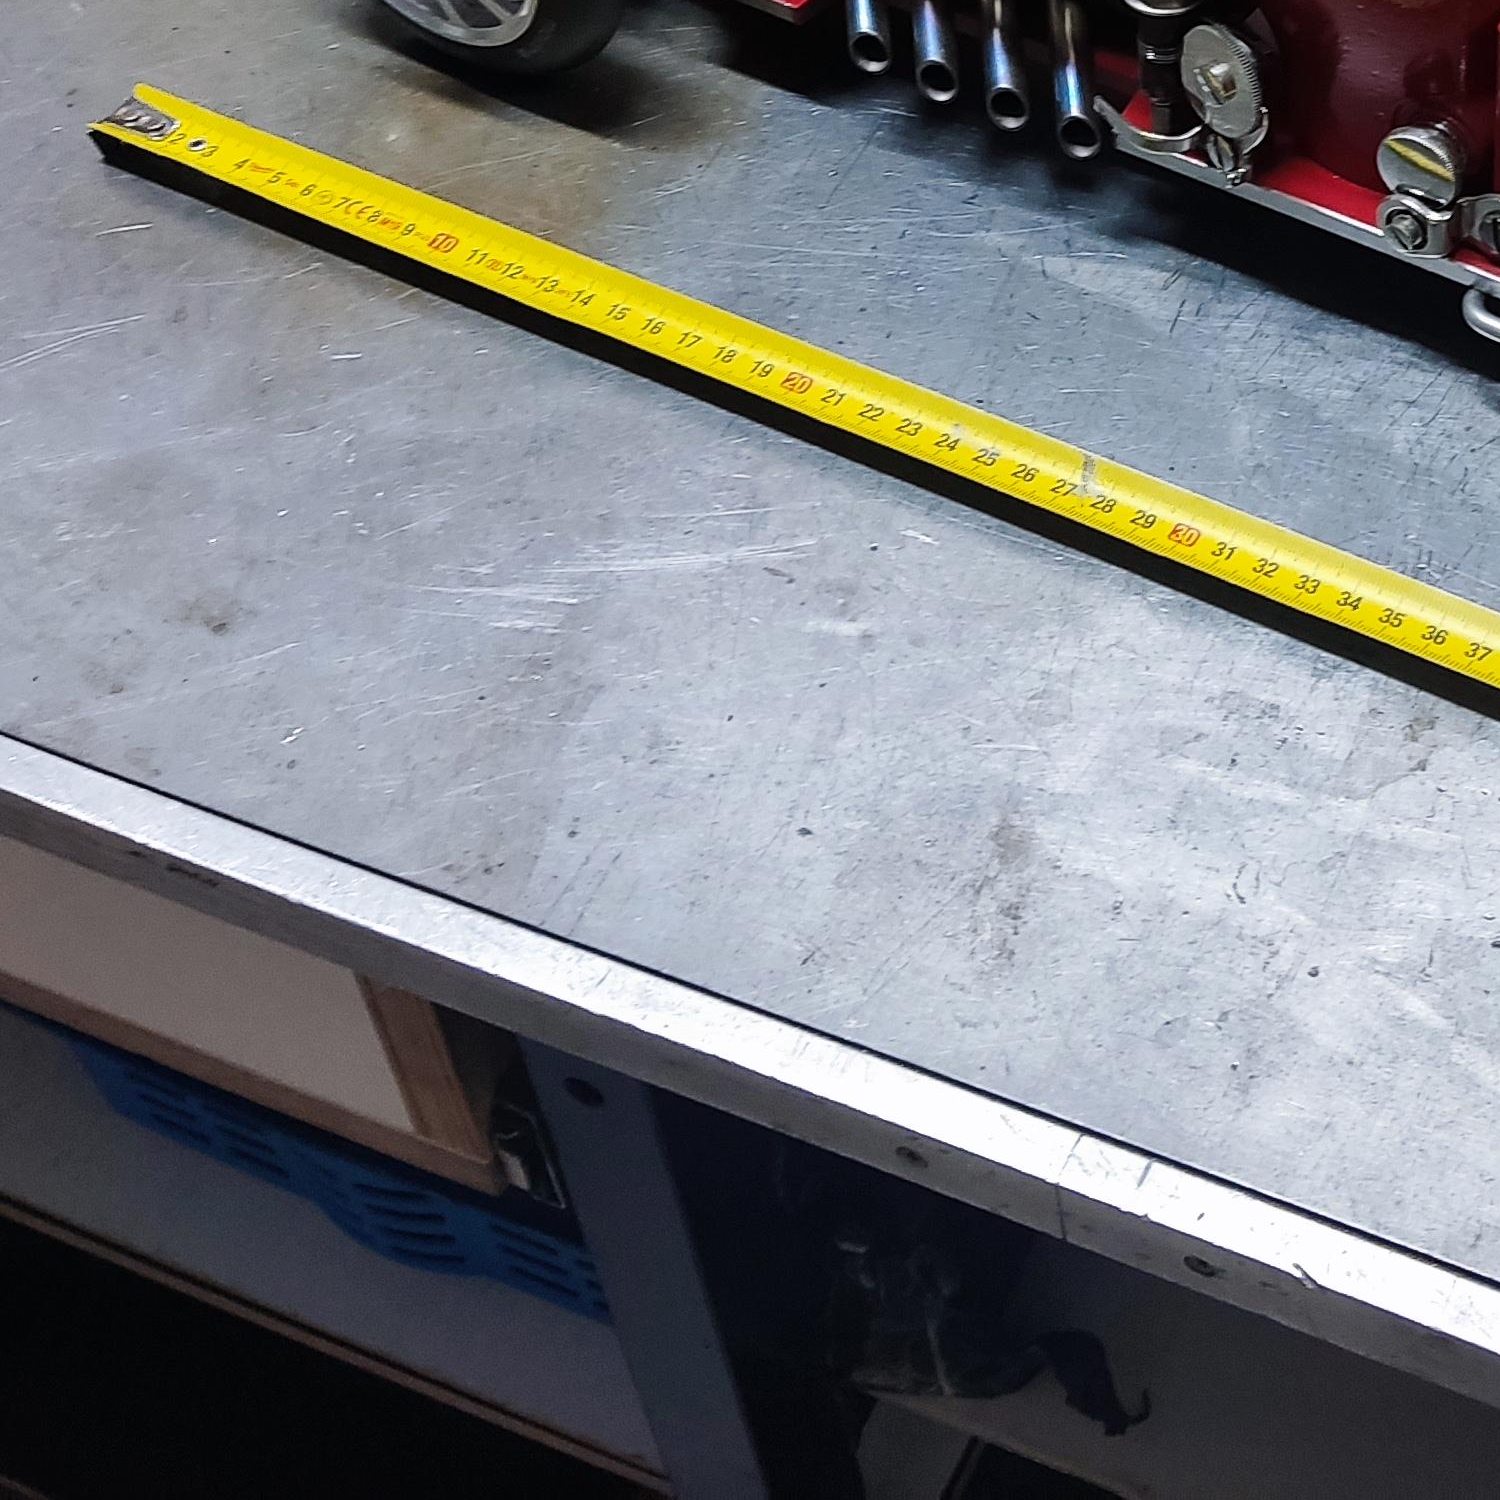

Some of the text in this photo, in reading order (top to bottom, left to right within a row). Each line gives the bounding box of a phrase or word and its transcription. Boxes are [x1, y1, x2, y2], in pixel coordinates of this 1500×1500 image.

[233, 158, 251, 171] 4
[267, 171, 286, 185] 5
[300, 183, 317, 197] 6
[367, 210, 383, 223] 8
[401, 223, 416, 236] 9
[430, 234, 457, 253] 10
[465, 248, 488, 265] 11
[501, 262, 525, 279] 12
[536, 276, 560, 292] 13
[571, 289, 597, 307] 14
[605, 303, 631, 321] 15
[640, 317, 666, 335] 16
[677, 331, 703, 348] 17
[712, 345, 738, 364] 18
[748, 360, 775, 378] 19
[783, 373, 812, 393] 20
[820, 388, 847, 407] 21
[858, 403, 885, 422] 22
[896, 418, 922, 437] 23
[934, 433, 959, 451] 24
[972, 449, 999, 467] 25
[1011, 463, 1039, 482] 26
[1049, 479, 1077, 498] 27
[1089, 495, 1117, 514] 28
[1129, 509, 1157, 529] 29
[1171, 524, 1199, 546] 30
[1211, 541, 1238, 561] 31
[1252, 557, 1279, 578] 32
[1293, 574, 1320, 595] 33
[1336, 590, 1363, 611] 34
[1378, 607, 1406, 628] 35
[1420, 625, 1449, 646] 36
[1463, 642, 1493, 662] 37
